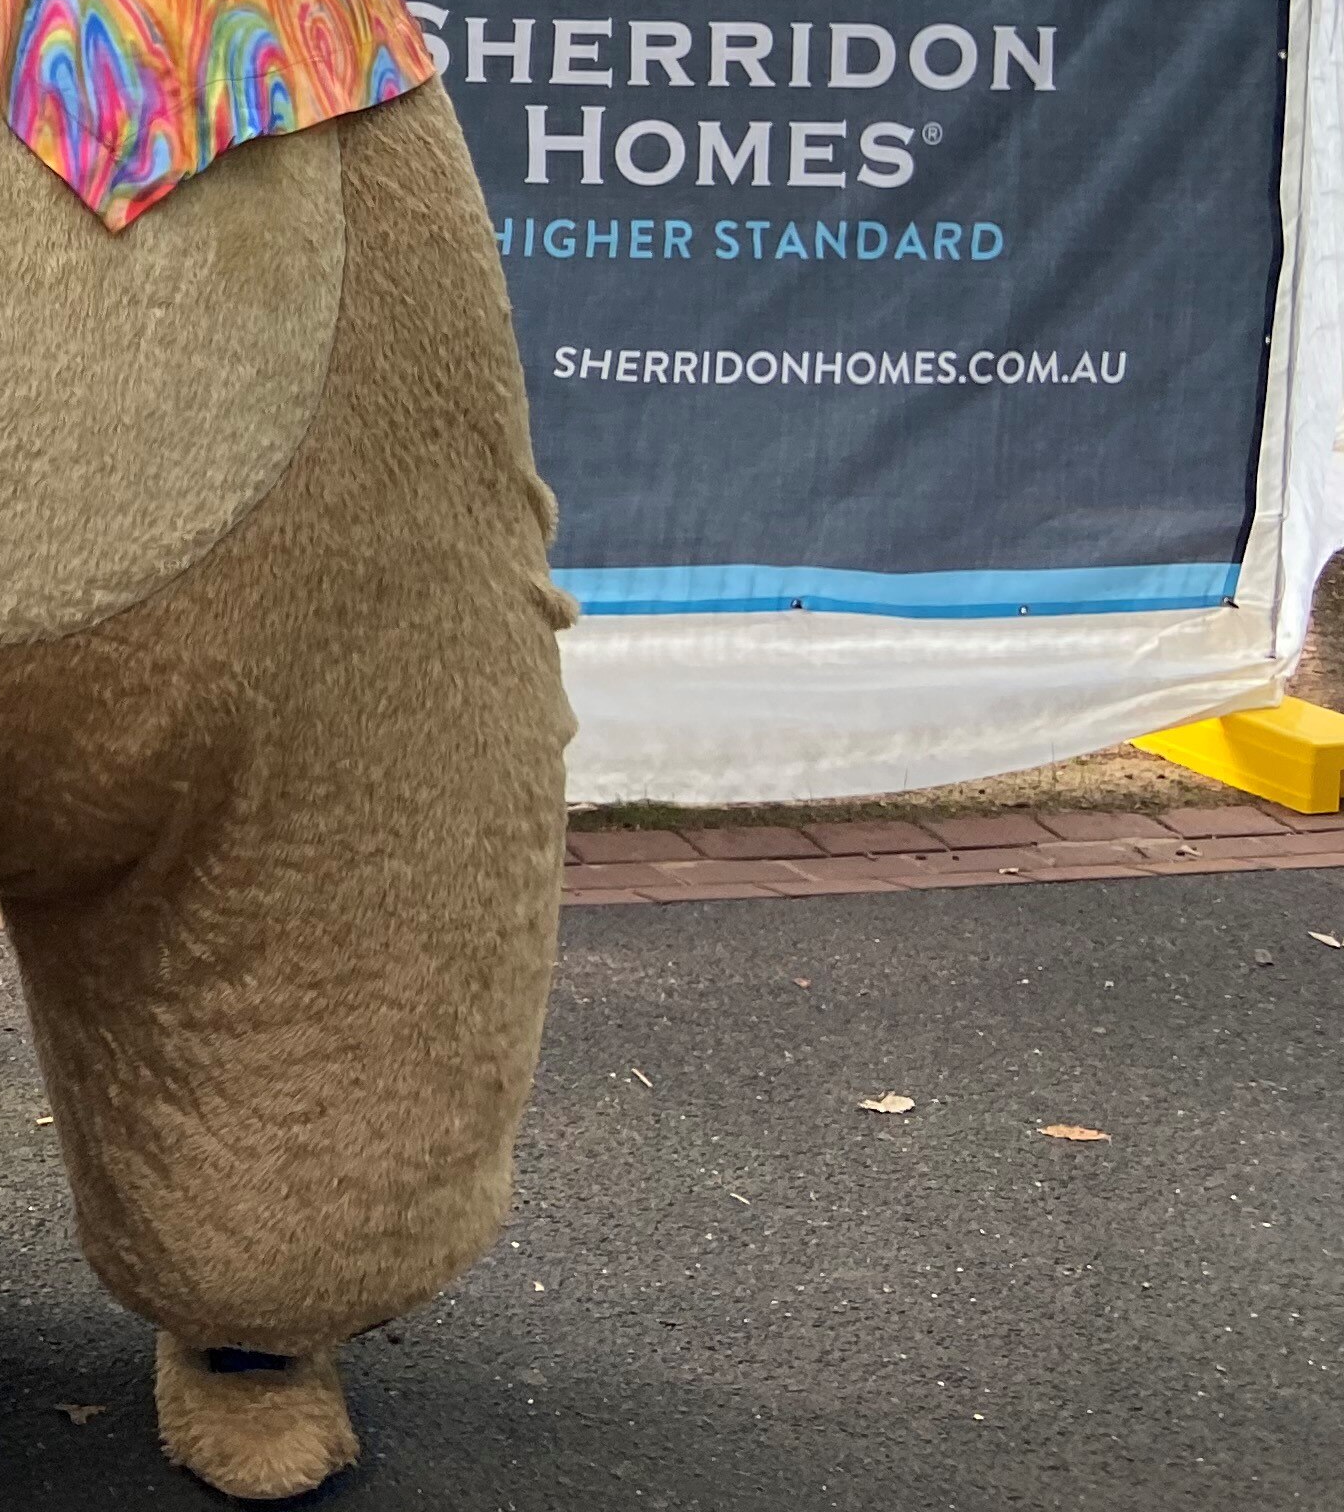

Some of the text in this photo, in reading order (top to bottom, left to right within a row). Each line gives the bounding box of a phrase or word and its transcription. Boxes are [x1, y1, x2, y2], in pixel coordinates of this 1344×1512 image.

[405, 1, 1057, 91] SHERRIDON
[715, 219, 1006, 262] STANDARD
[553, 346, 1127, 385] SHERRIDONHOMES.COM.AU
